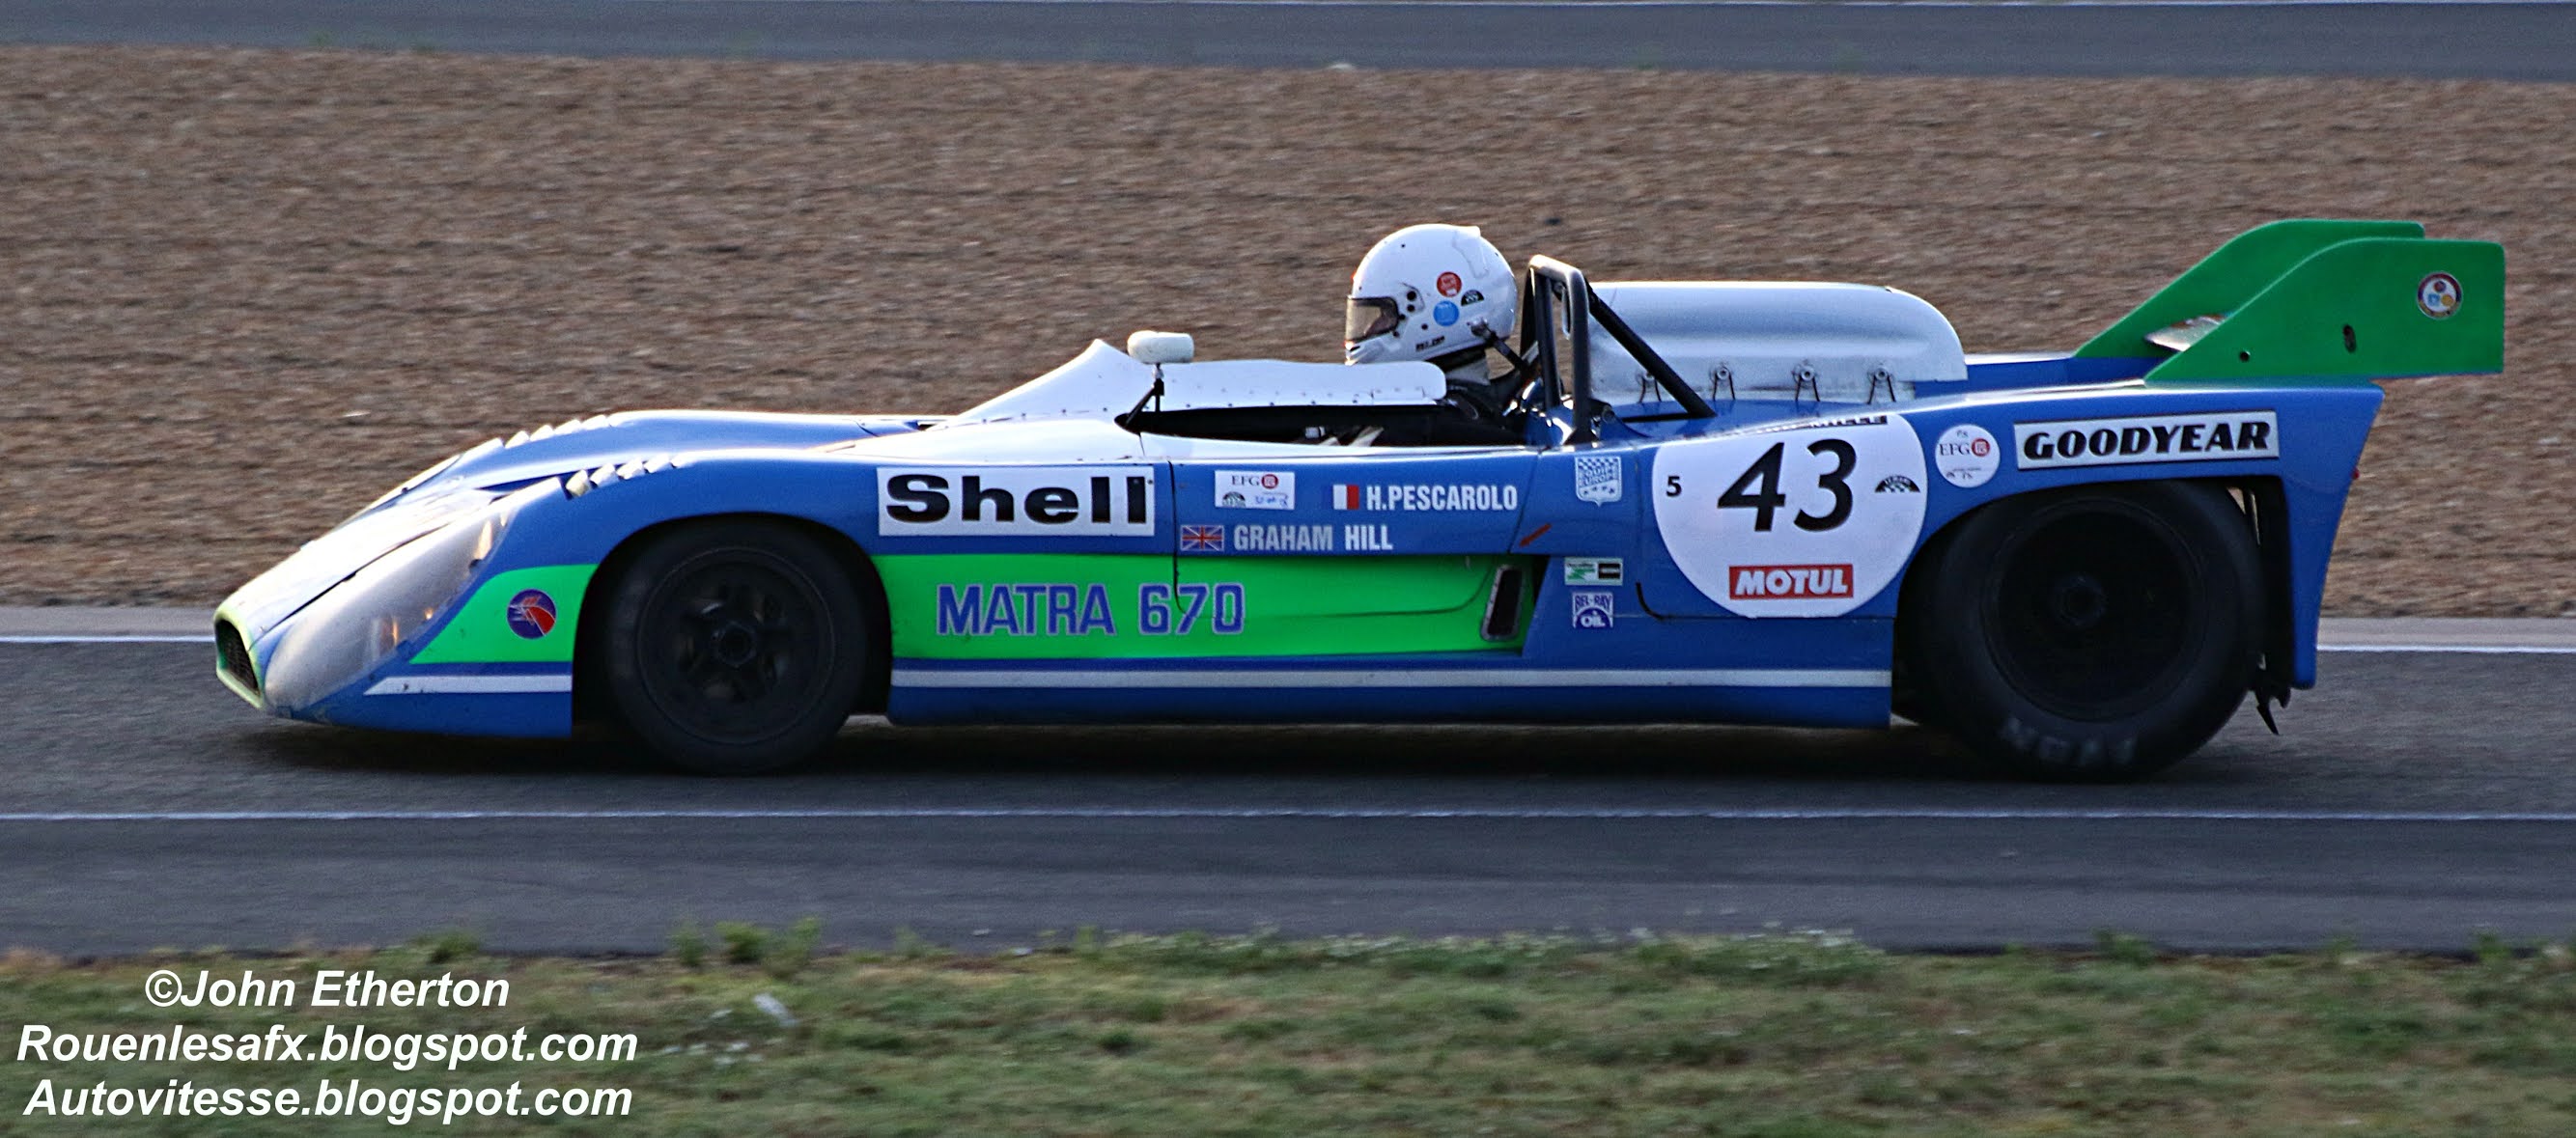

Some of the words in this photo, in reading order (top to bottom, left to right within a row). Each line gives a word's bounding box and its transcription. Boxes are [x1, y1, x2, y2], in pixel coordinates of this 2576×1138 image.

[1939, 443, 1971, 457] EFG
[2025, 422, 2270, 460] GOODYEAR
[885, 474, 1147, 525] Shell
[1366, 485, 1518, 512] H.PESCAROLO
[1666, 475, 1682, 497] 5
[1717, 438, 1857, 532] 43
[1234, 524, 1333, 551] GRAHAM
[1344, 524, 1393, 551] HILL
[1734, 568, 1849, 597] MOTUL
[937, 584, 1117, 635] MATRA
[1139, 583, 1246, 635] 670
